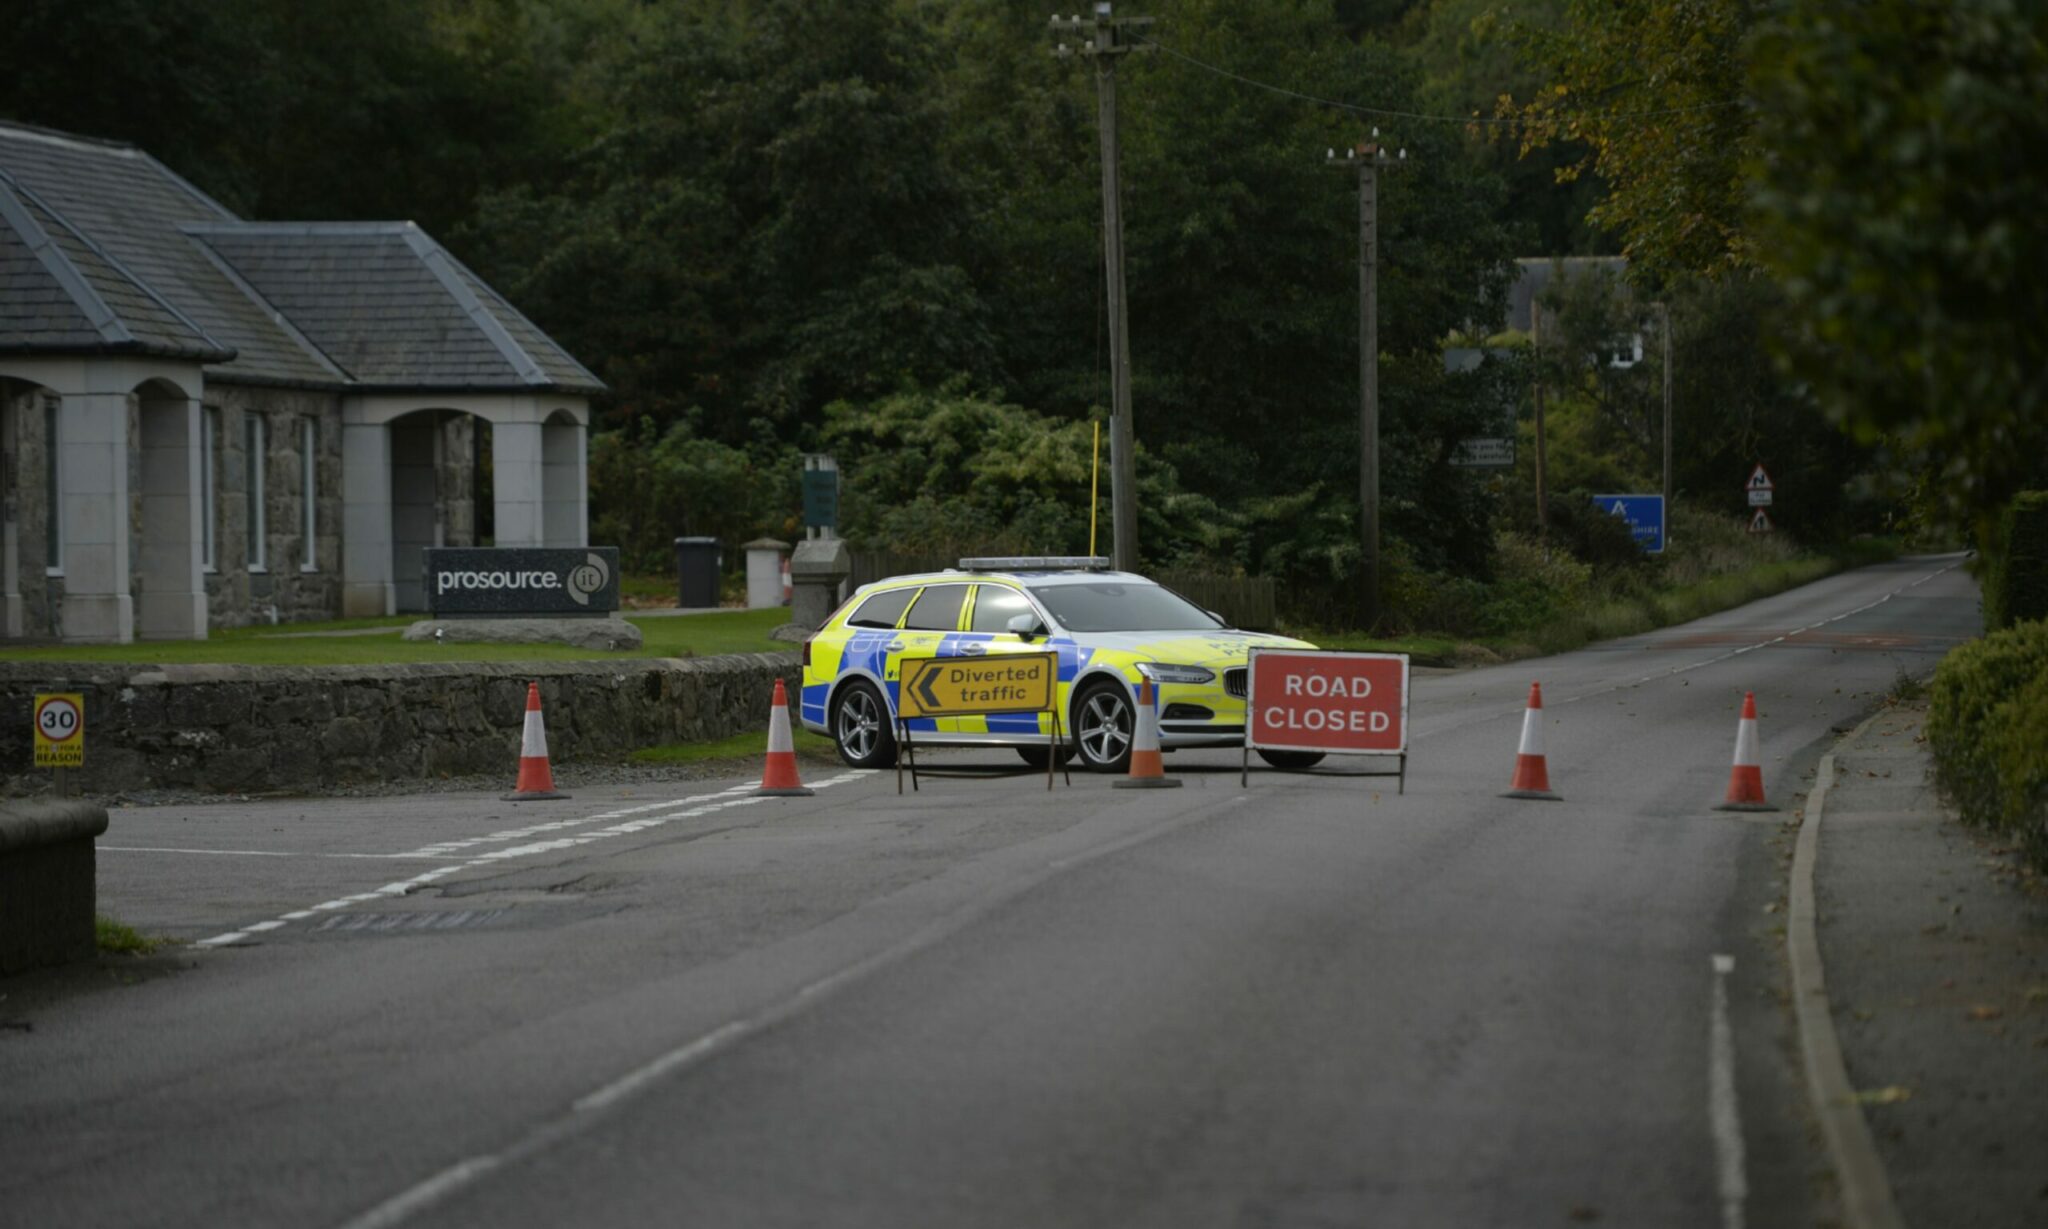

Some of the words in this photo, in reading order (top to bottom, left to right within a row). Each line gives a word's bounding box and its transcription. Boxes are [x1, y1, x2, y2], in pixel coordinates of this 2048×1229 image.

[581, 570, 595, 587] it
[950, 665, 1040, 684] Diverted
[960, 685, 1027, 703] traffic
[1285, 674, 1372, 698] ROAD
[43, 710, 74, 728] 30
[1264, 706, 1390, 732] CLOSED
[36, 752, 81, 762] REASON
